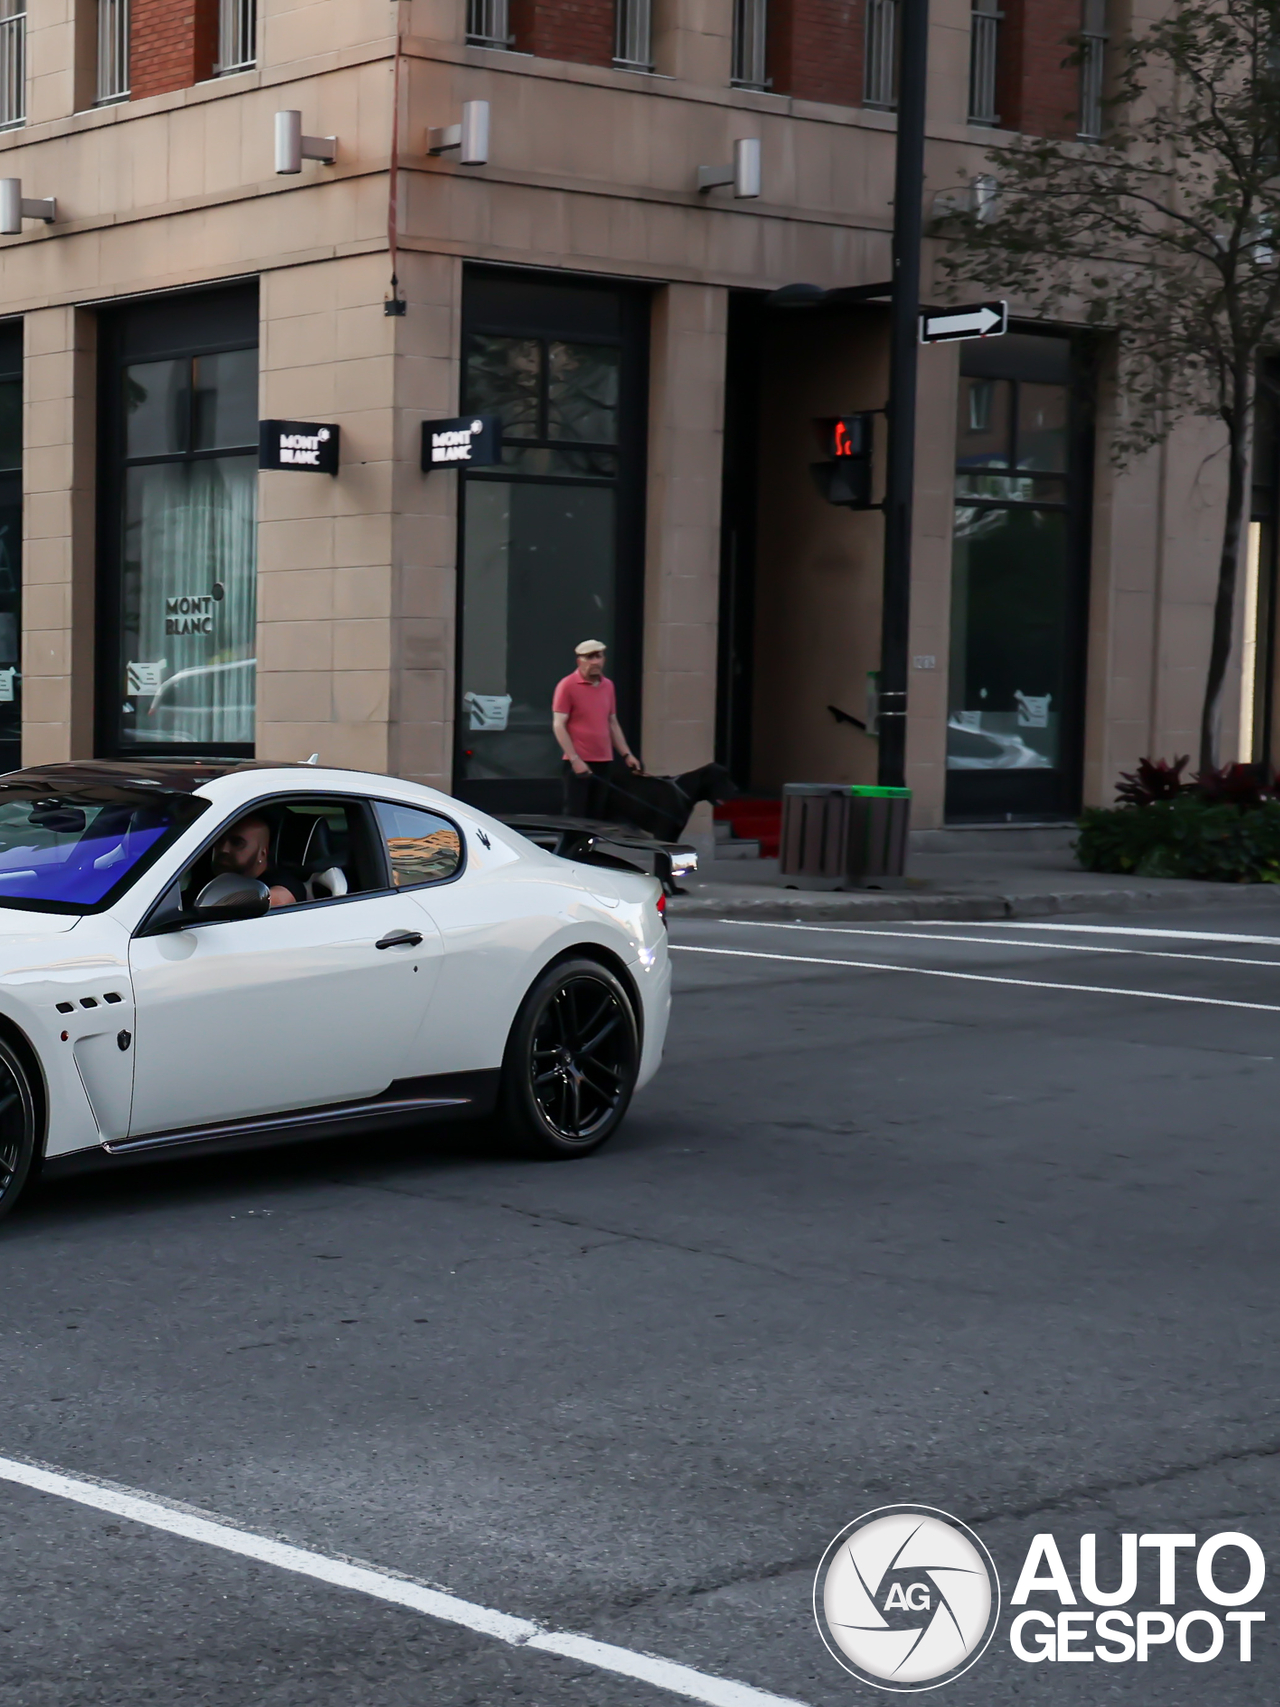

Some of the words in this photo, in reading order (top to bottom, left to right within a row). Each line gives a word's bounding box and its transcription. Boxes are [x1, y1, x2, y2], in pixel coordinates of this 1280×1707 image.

[280, 433, 319, 450] MONT
[432, 429, 472, 447] MONT
[280, 449, 320, 466] BLANC
[432, 445, 472, 463] BLANC
[165, 597, 212, 616] MONT
[165, 617, 213, 636] BLANC
